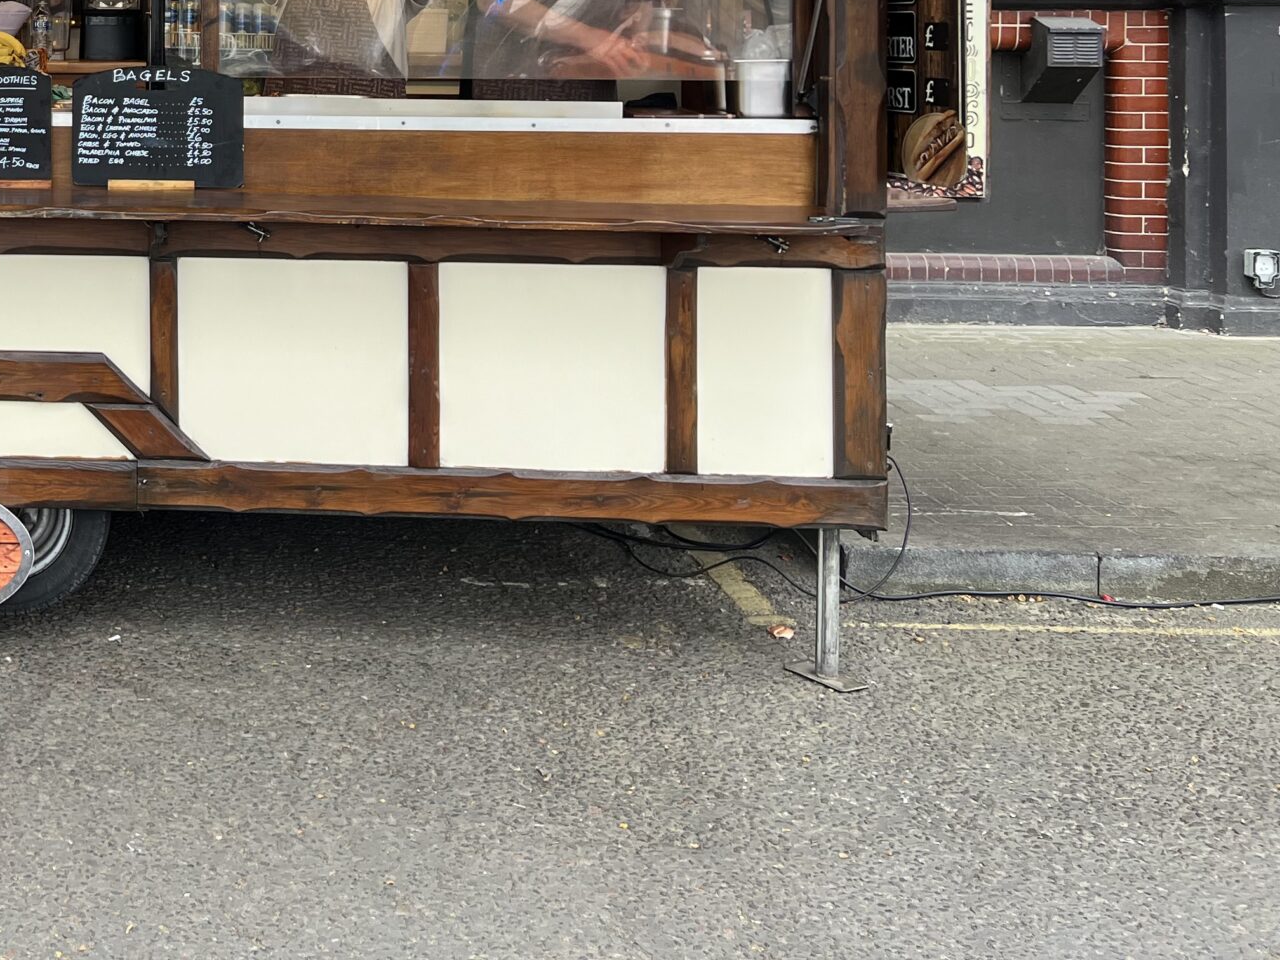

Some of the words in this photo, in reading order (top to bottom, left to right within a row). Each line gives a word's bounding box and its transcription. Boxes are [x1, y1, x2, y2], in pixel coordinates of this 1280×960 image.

[925, 25, 934, 47] £
[113, 69, 191, 83] BAGELS
[925, 80, 934, 103] £
[83, 95, 116, 105] BACON
[123, 98, 150, 106] BAGEL
[189, 97, 204, 106] £5
[82, 105, 107, 114] BACON
[81, 115, 104, 123] BACON
